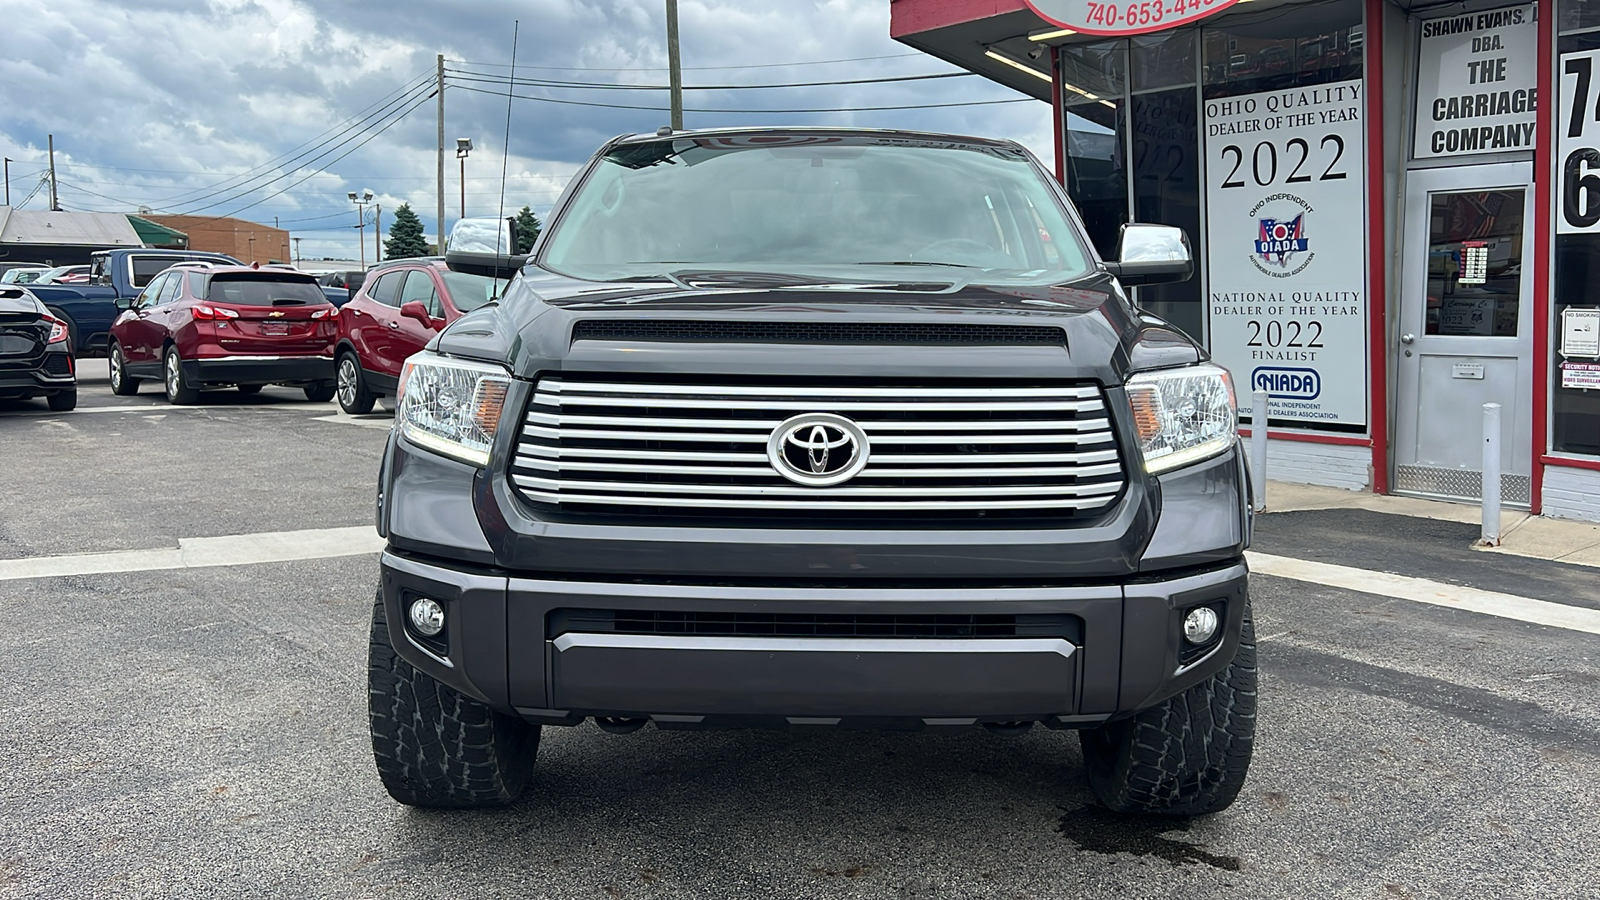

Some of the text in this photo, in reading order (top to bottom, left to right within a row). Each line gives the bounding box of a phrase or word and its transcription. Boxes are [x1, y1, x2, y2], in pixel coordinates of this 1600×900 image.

[1423, 16, 1473, 38] SHAWN
[1476, 8, 1526, 31] EVANS.
[1471, 34, 1505, 54] DBA.
[1467, 57, 1507, 85] THE
[1206, 98, 1257, 118] OHIO
[1266, 84, 1361, 113] QUALITY
[1432, 87, 1538, 122] CARRIAGE
[1209, 118, 1261, 137] DEALER
[1264, 115, 1283, 131] OF
[1286, 112, 1315, 128] THE
[1319, 107, 1359, 124] YEAR
[1431, 122, 1537, 154] COMPANY
[1220, 133, 1347, 189] 2022
[1249, 193, 1314, 218] OHIO INDEPENDENT
[1260, 240, 1300, 253] OIADA
[1249, 252, 1316, 279] AUTOMOBILE DEALERS ASSOCIATION
[1212, 291, 1360, 304] NATIONAL QUALITY
[1214, 306, 1359, 316] DEALER OF THE YEAR
[1246, 320, 1324, 348] 2022
[1252, 350, 1317, 361] FINALIST
[1257, 373, 1314, 393] NIADA
[1273, 409, 1297, 417] DEALERS
[1298, 410, 1339, 420] ASSOCIATION
[1281, 402, 1321, 410] INDEPENDENT
